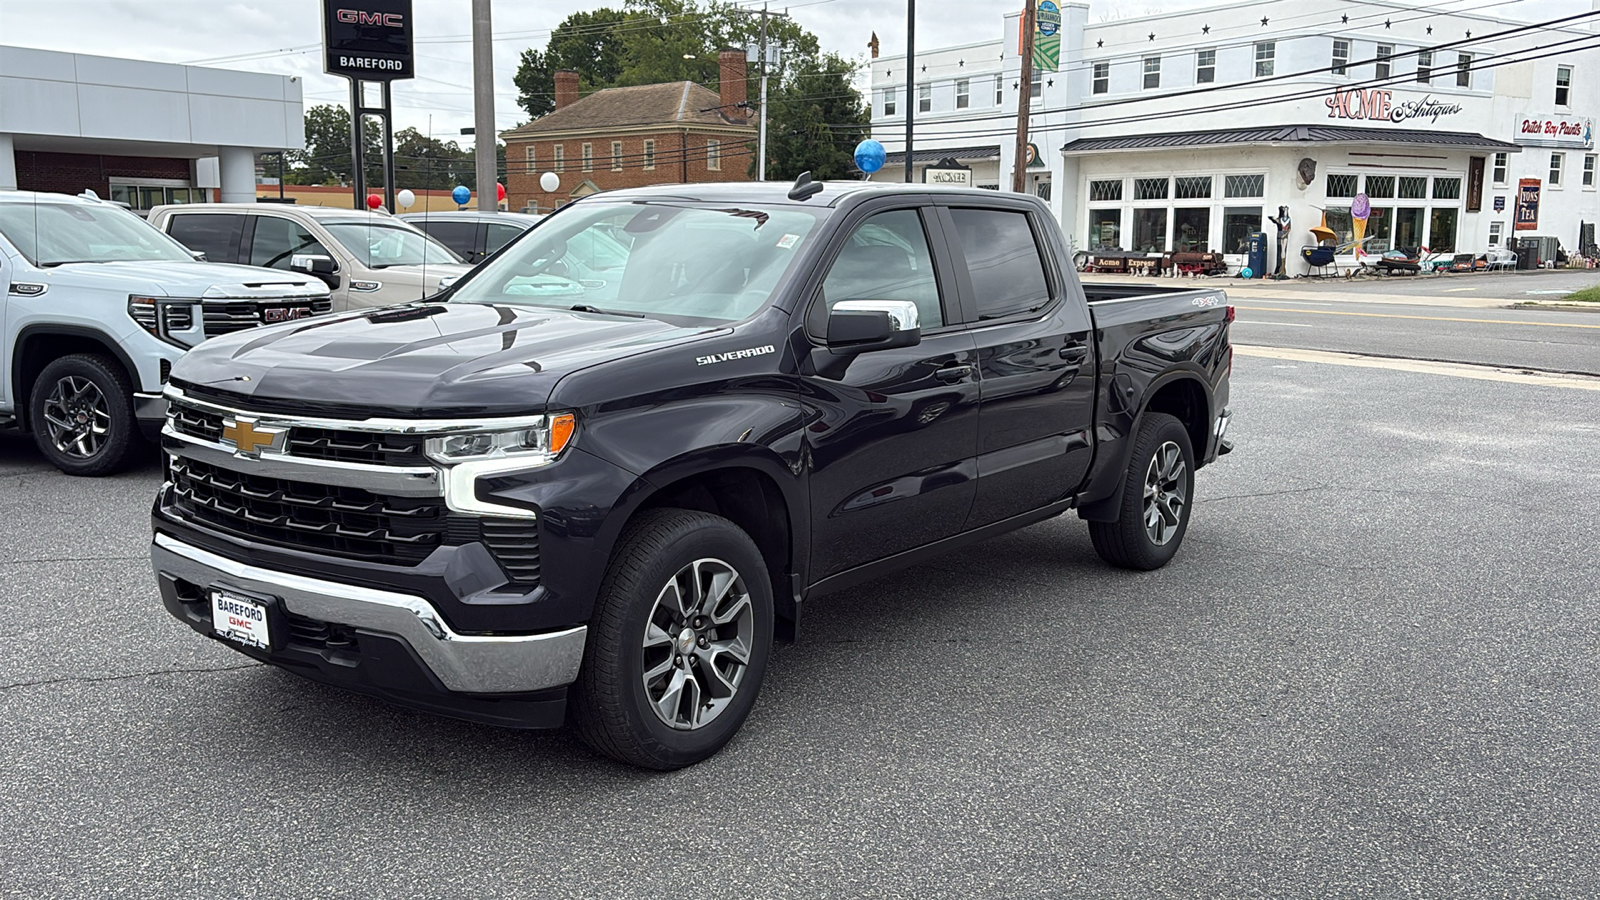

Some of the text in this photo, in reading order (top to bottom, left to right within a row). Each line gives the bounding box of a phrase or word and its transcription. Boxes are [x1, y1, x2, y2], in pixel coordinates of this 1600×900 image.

[337, 9, 403, 27] GMC
[340, 56, 403, 70] BAREFORD
[1325, 87, 1462, 124] ACME Antiques
[1521, 119, 1582, 138] Dutch Boy Paints
[1521, 207, 1535, 220] TEA
[1128, 259, 1155, 267] Express
[264, 307, 310, 321] GMC
[695, 344, 776, 366] SILVERADO
[218, 599, 262, 621] BAREFORD
[229, 616, 253, 630] GMC
